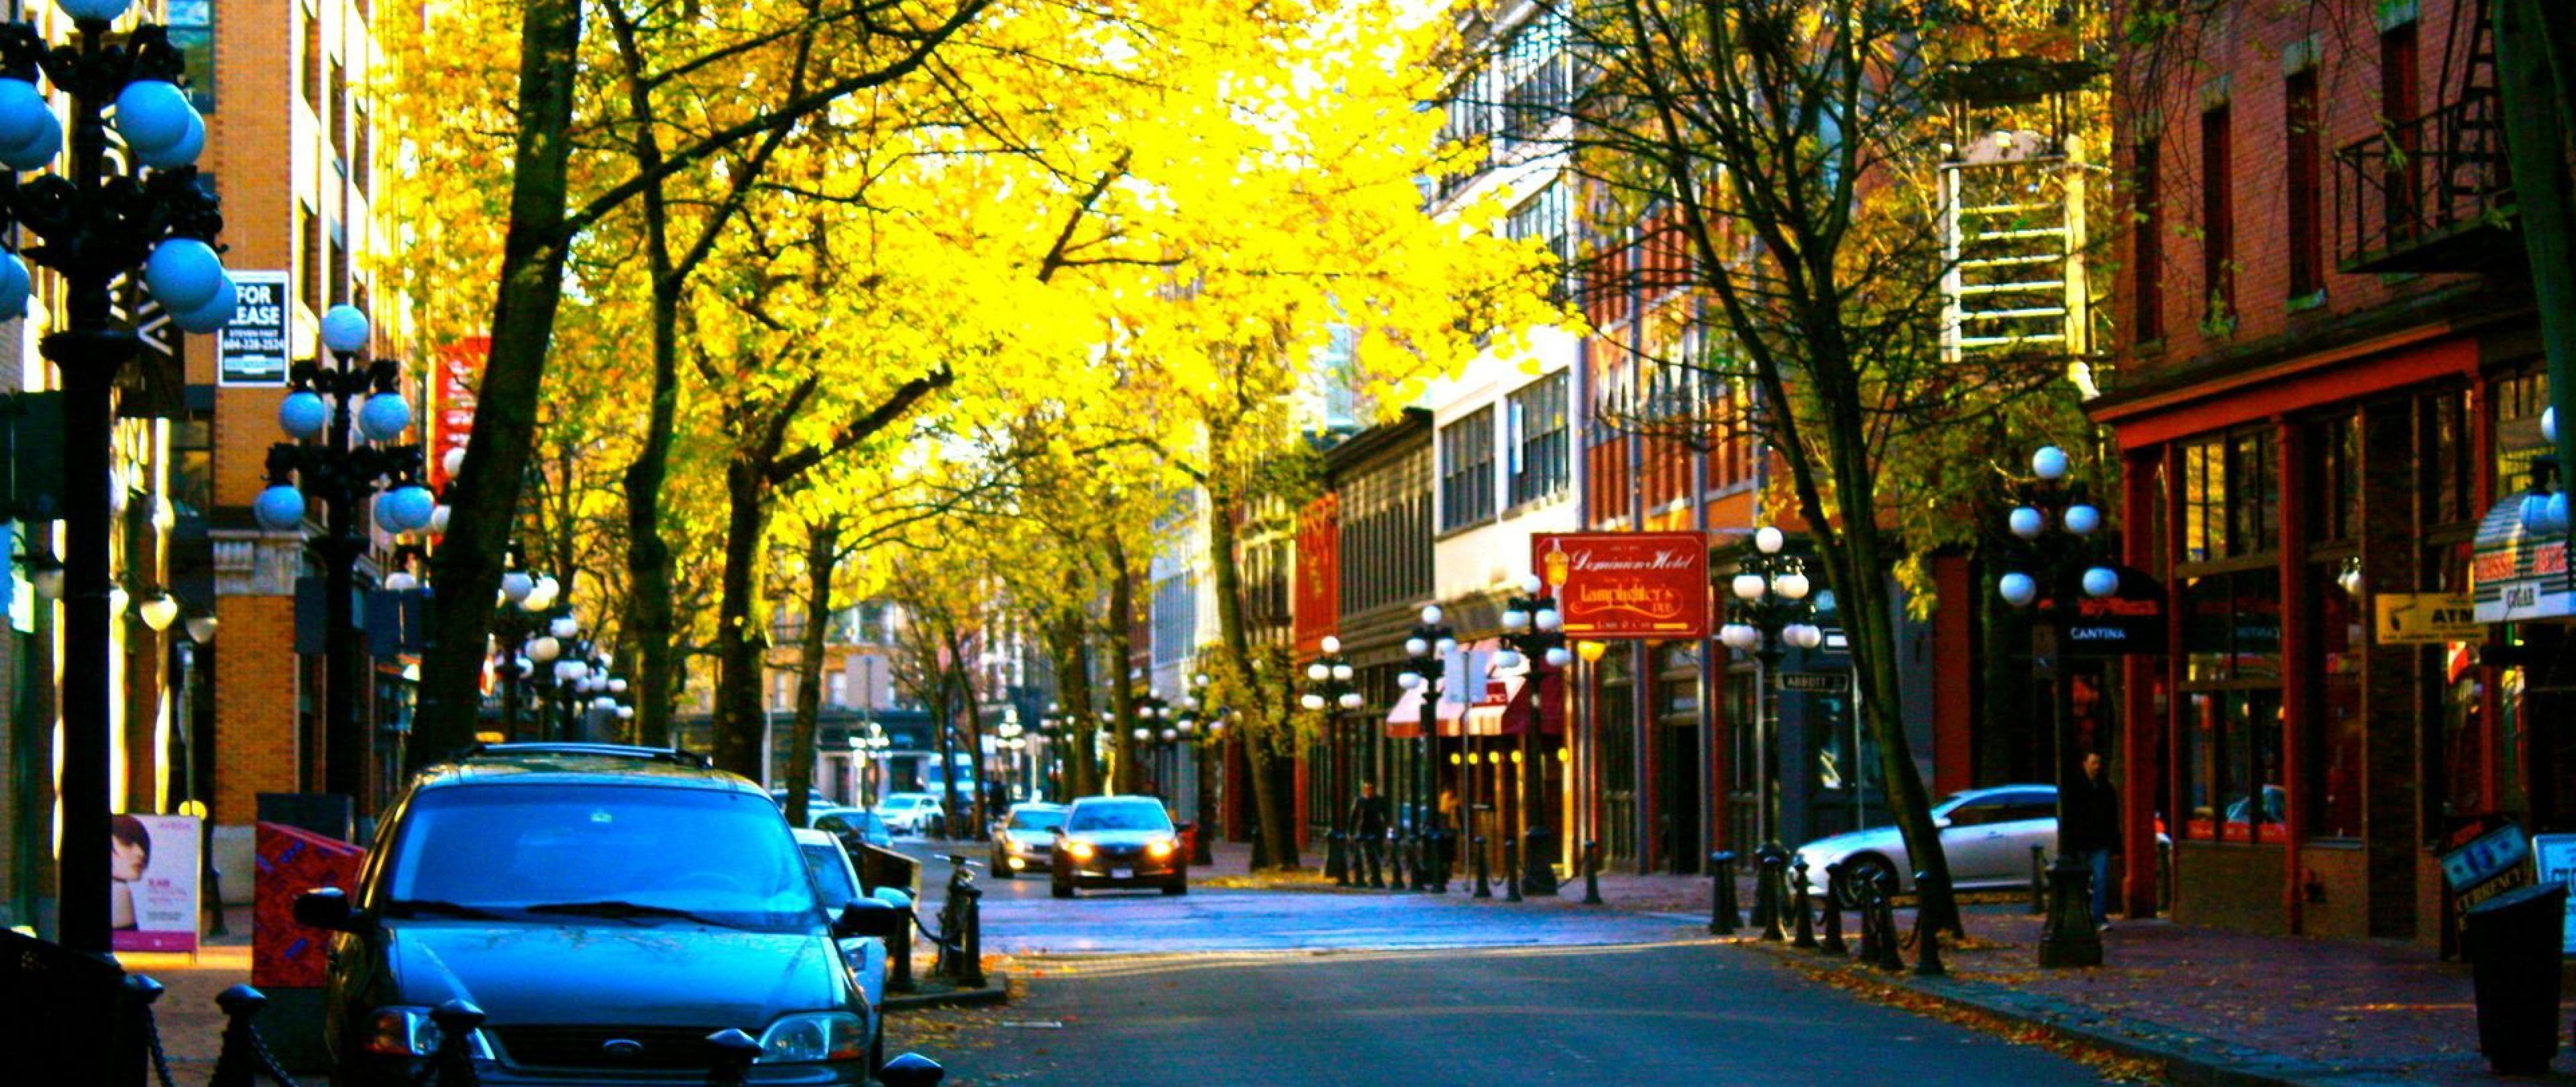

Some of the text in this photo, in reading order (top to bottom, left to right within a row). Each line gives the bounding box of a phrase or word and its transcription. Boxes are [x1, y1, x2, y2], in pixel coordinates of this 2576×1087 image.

[236, 285, 271, 304] FOR
[1570, 549, 1695, 571] Dominion Hotel
[1580, 584, 1674, 606] Lamplighter's
[2432, 608, 2474, 624] ATM
[2070, 627, 2126, 640] CANTINA
[1786, 676, 1826, 686] ABBOTT
